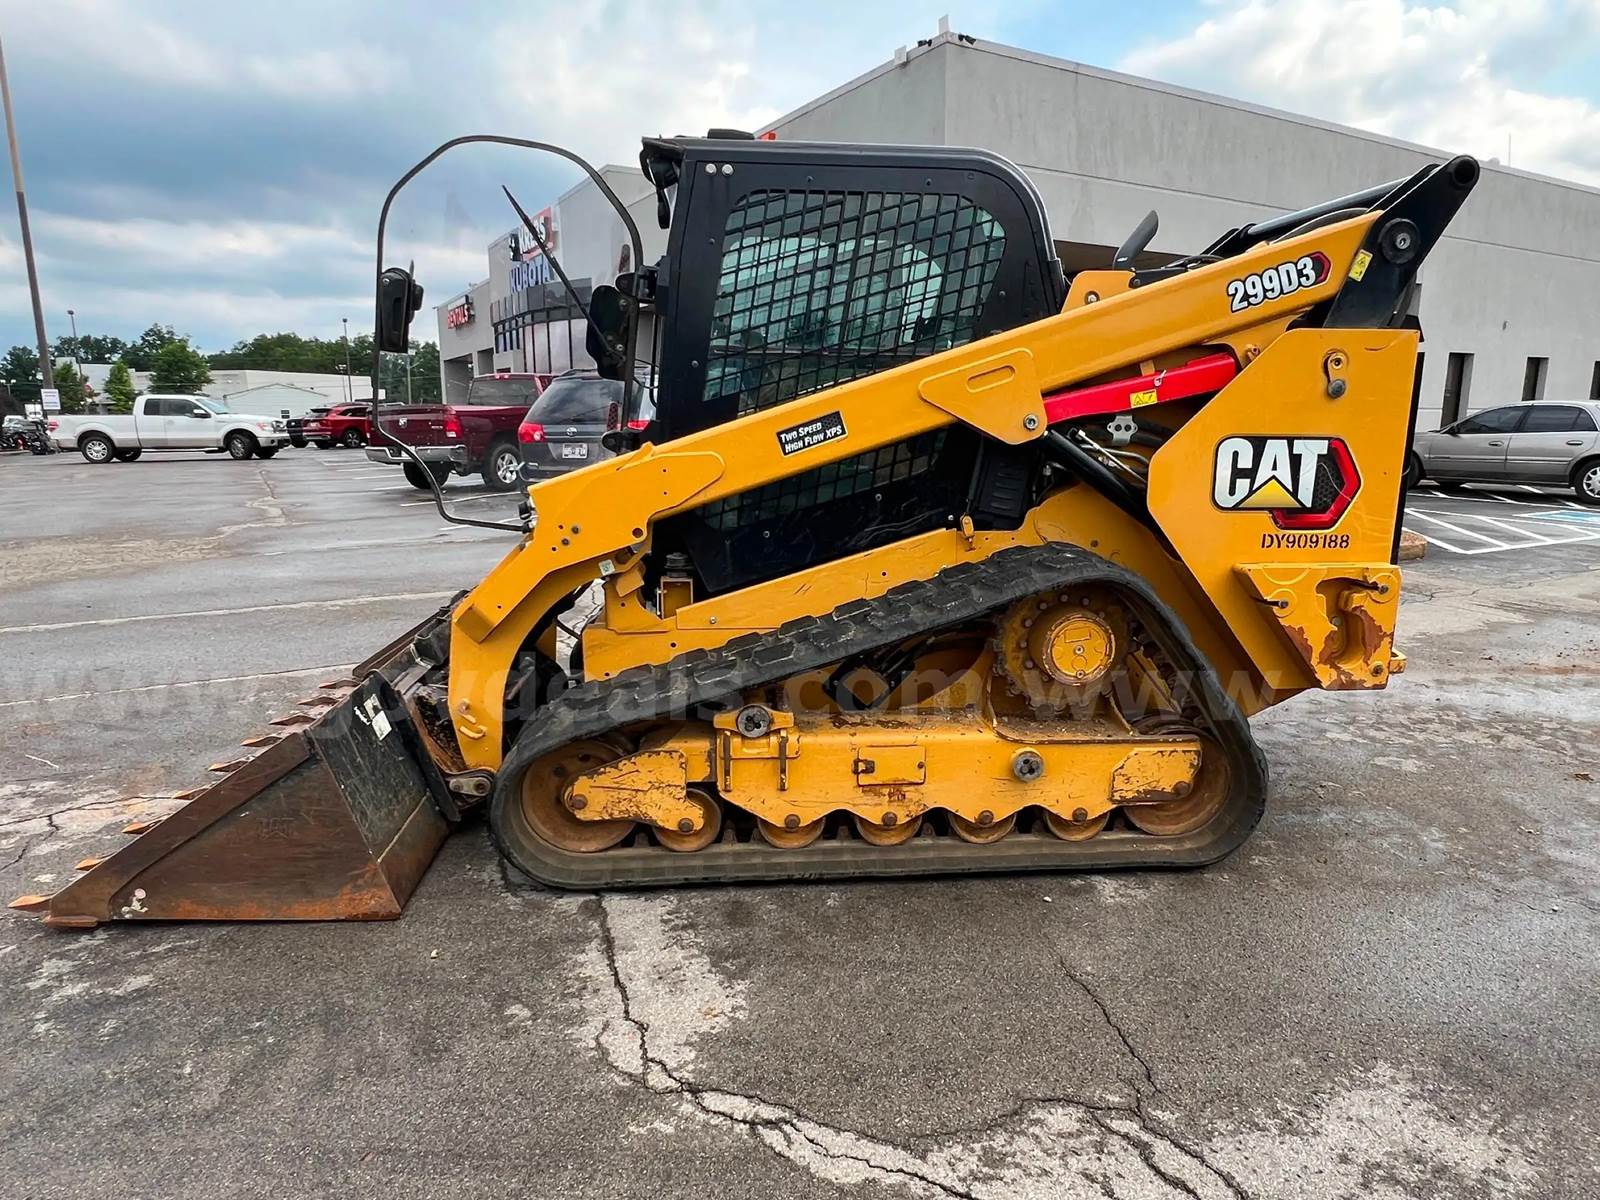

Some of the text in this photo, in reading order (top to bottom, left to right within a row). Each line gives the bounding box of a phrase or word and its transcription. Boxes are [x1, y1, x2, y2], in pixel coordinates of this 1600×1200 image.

[510, 257, 550, 294] KUBOTA
[1228, 256, 1316, 311] 299D3
[798, 422, 822, 437] SPEED
[826, 425, 843, 439] XPS
[1216, 438, 1328, 508] CAT
[1261, 533, 1350, 549] DY909188
